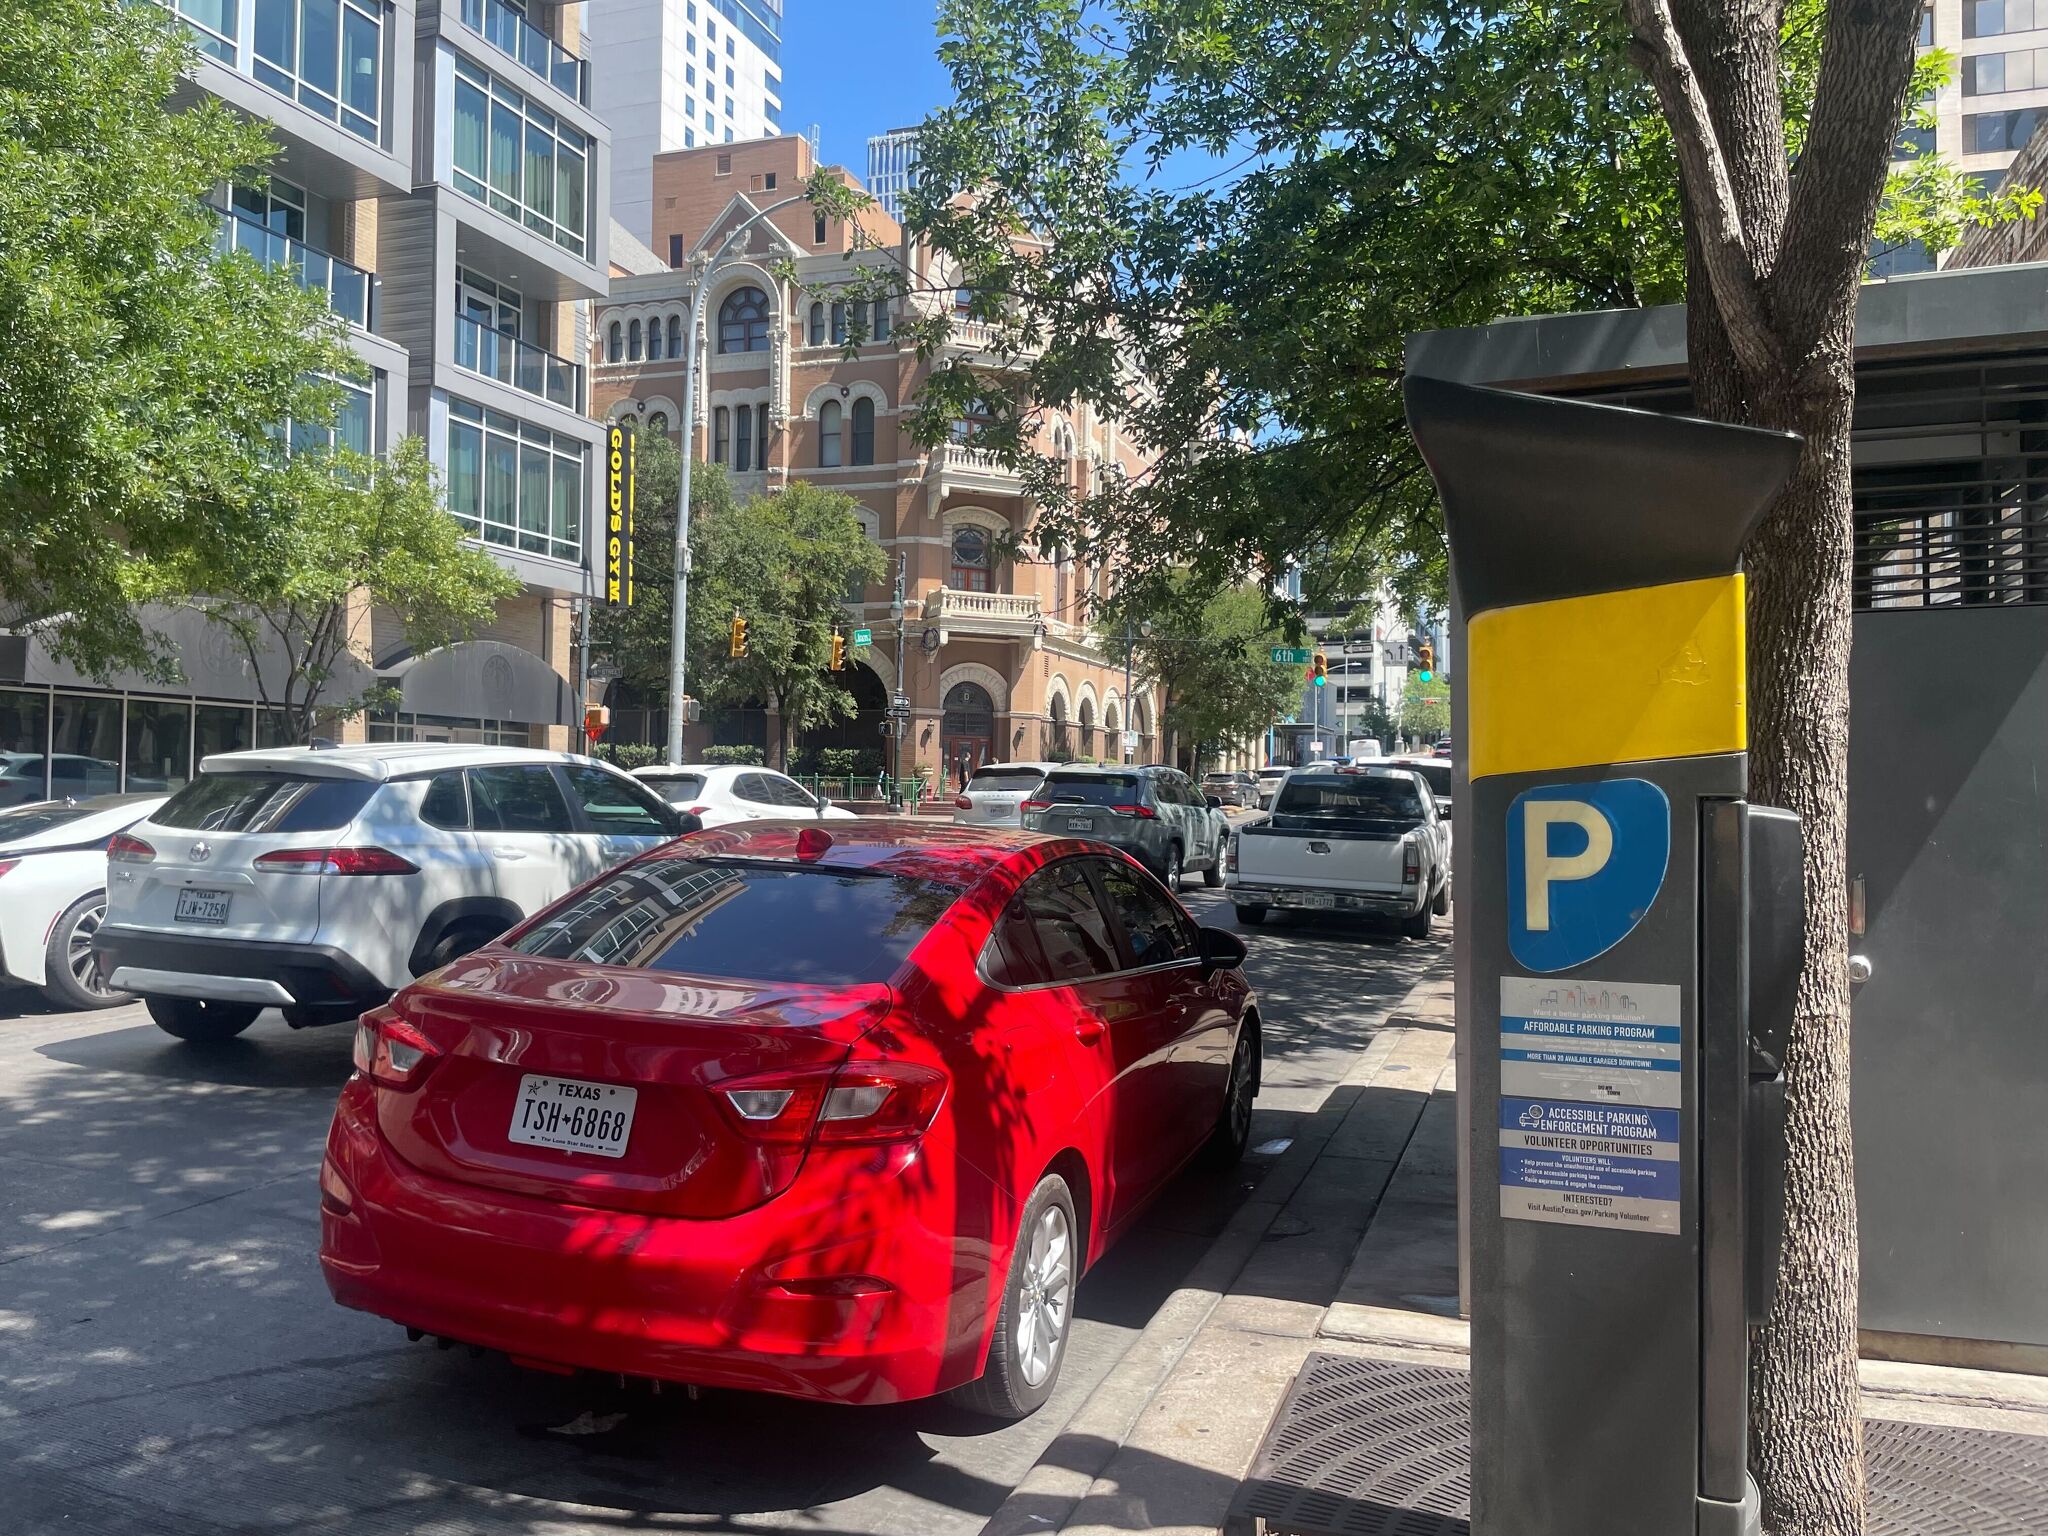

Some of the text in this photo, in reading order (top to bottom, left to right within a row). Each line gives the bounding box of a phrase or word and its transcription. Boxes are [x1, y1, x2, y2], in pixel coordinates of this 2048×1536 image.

[870, 138, 897, 148] HYATT
[609, 428, 623, 603] GOLD'S GYM
[1275, 650, 1294, 662] 6th
[1524, 801, 1612, 931] P
[1582, 1011, 1610, 1021] parking
[1524, 1021, 1655, 1038] AFFORDABLE PARKING PROGRAM
[1565, 1055, 1592, 1064] AVAILABLE
[1593, 1057, 1617, 1066] GARAGES
[1619, 1059, 1652, 1067] DOWNTOWN!
[558, 1083, 601, 1101] TEXAS
[1549, 1108, 1648, 1125] ACCESSIBLE PARKING
[1541, 1120, 1657, 1139] ENFORCEMENT PROGRAM
[1524, 1135, 1653, 1155] VOLUNTEER OPPORTUNITIES
[1562, 1155, 1597, 1164] VOLUNTEERS
[1536, 1160, 1554, 1168] prevent
[1564, 1163, 1594, 1171] unauthorized
[1611, 1167, 1636, 1175] accessible
[1637, 1169, 1657, 1178] parking
[1544, 1169, 1568, 1177] accessible
[1569, 1172, 1587, 1180] parking
[1588, 1172, 1600, 1180] laws
[1538, 1178, 1564, 1186] awareness
[1570, 1181, 1588, 1189] engage
[1597, 1184, 1624, 1192] community
[1563, 1193, 1613, 1207] INTERESTED?
[1528, 1202, 1541, 1211] Visit
[1620, 1211, 1650, 1222] Volunteer
